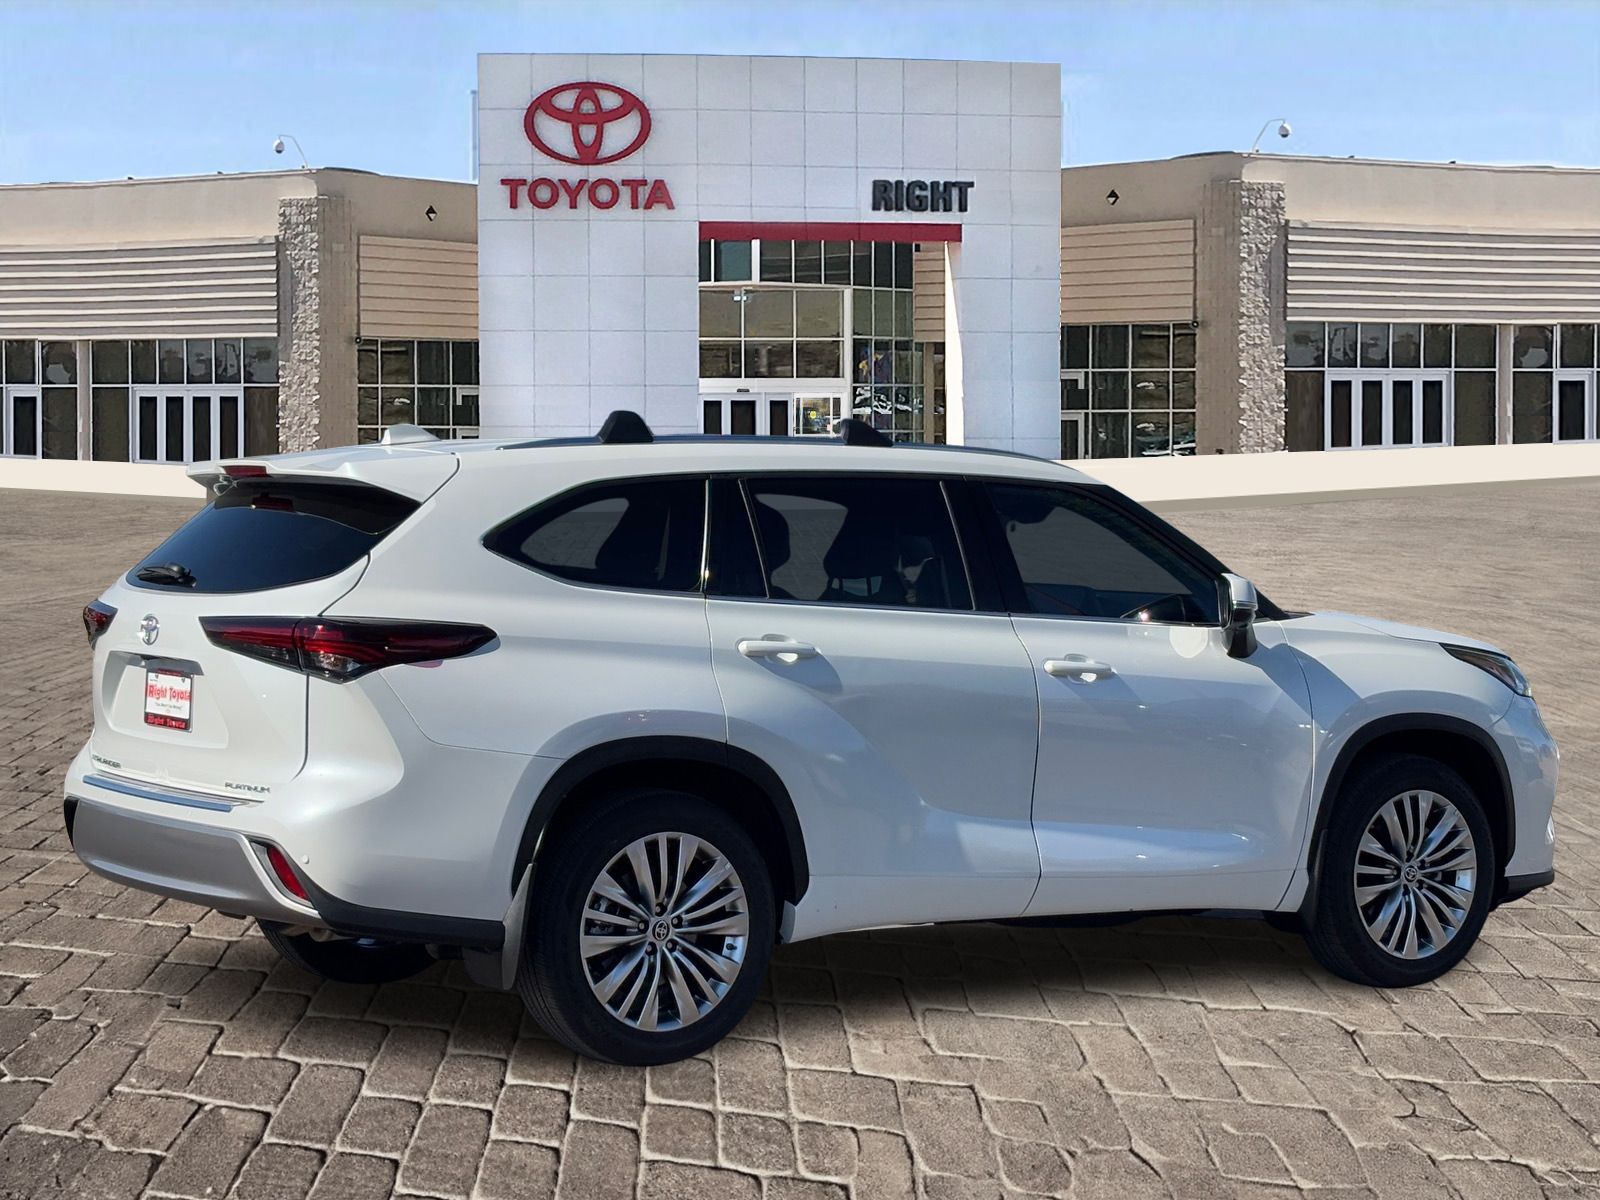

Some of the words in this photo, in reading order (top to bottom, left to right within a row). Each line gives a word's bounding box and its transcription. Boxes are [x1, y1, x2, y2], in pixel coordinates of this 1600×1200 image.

[500, 177, 676, 210] TOYOTA
[872, 179, 975, 212] RIGHT
[148, 684, 168, 700] Right
[224, 781, 271, 793] PLATINUM
